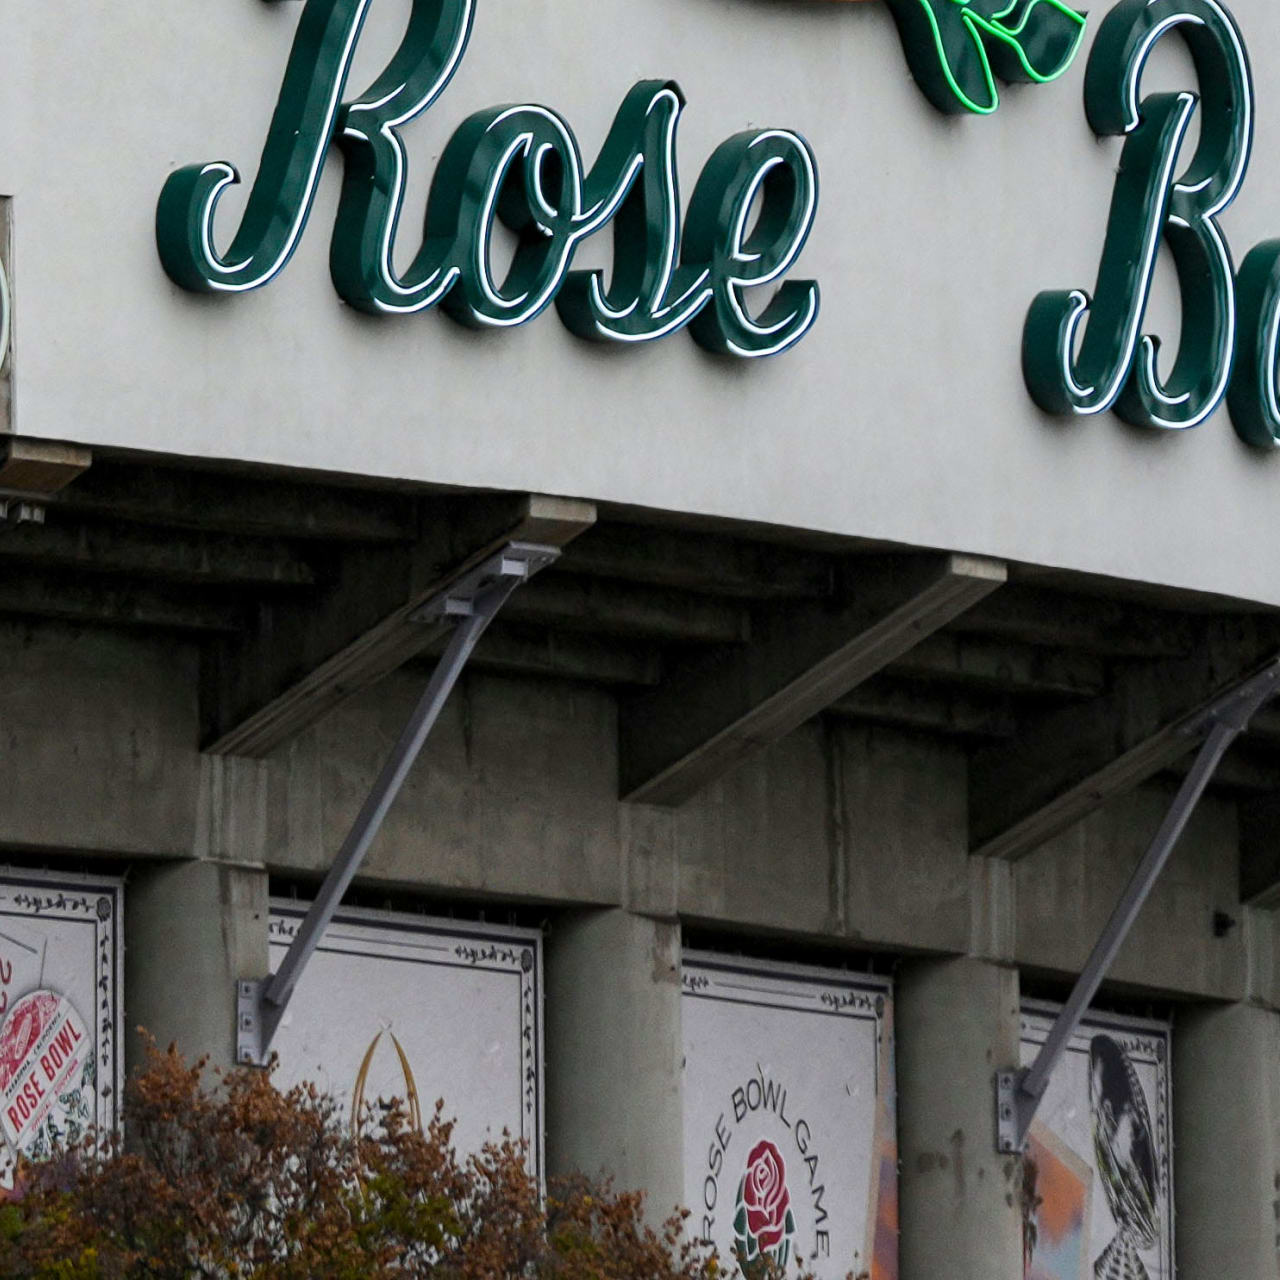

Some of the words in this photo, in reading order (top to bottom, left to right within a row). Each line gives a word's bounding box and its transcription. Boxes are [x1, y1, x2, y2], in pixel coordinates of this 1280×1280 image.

[7, 1070, 46, 1133] ROSE
[40, 1018, 82, 1082] BOWL
[703, 1112, 732, 1244] ROSE
[732, 1077, 791, 1129] BOWL
[795, 1119, 830, 1260] GAME
